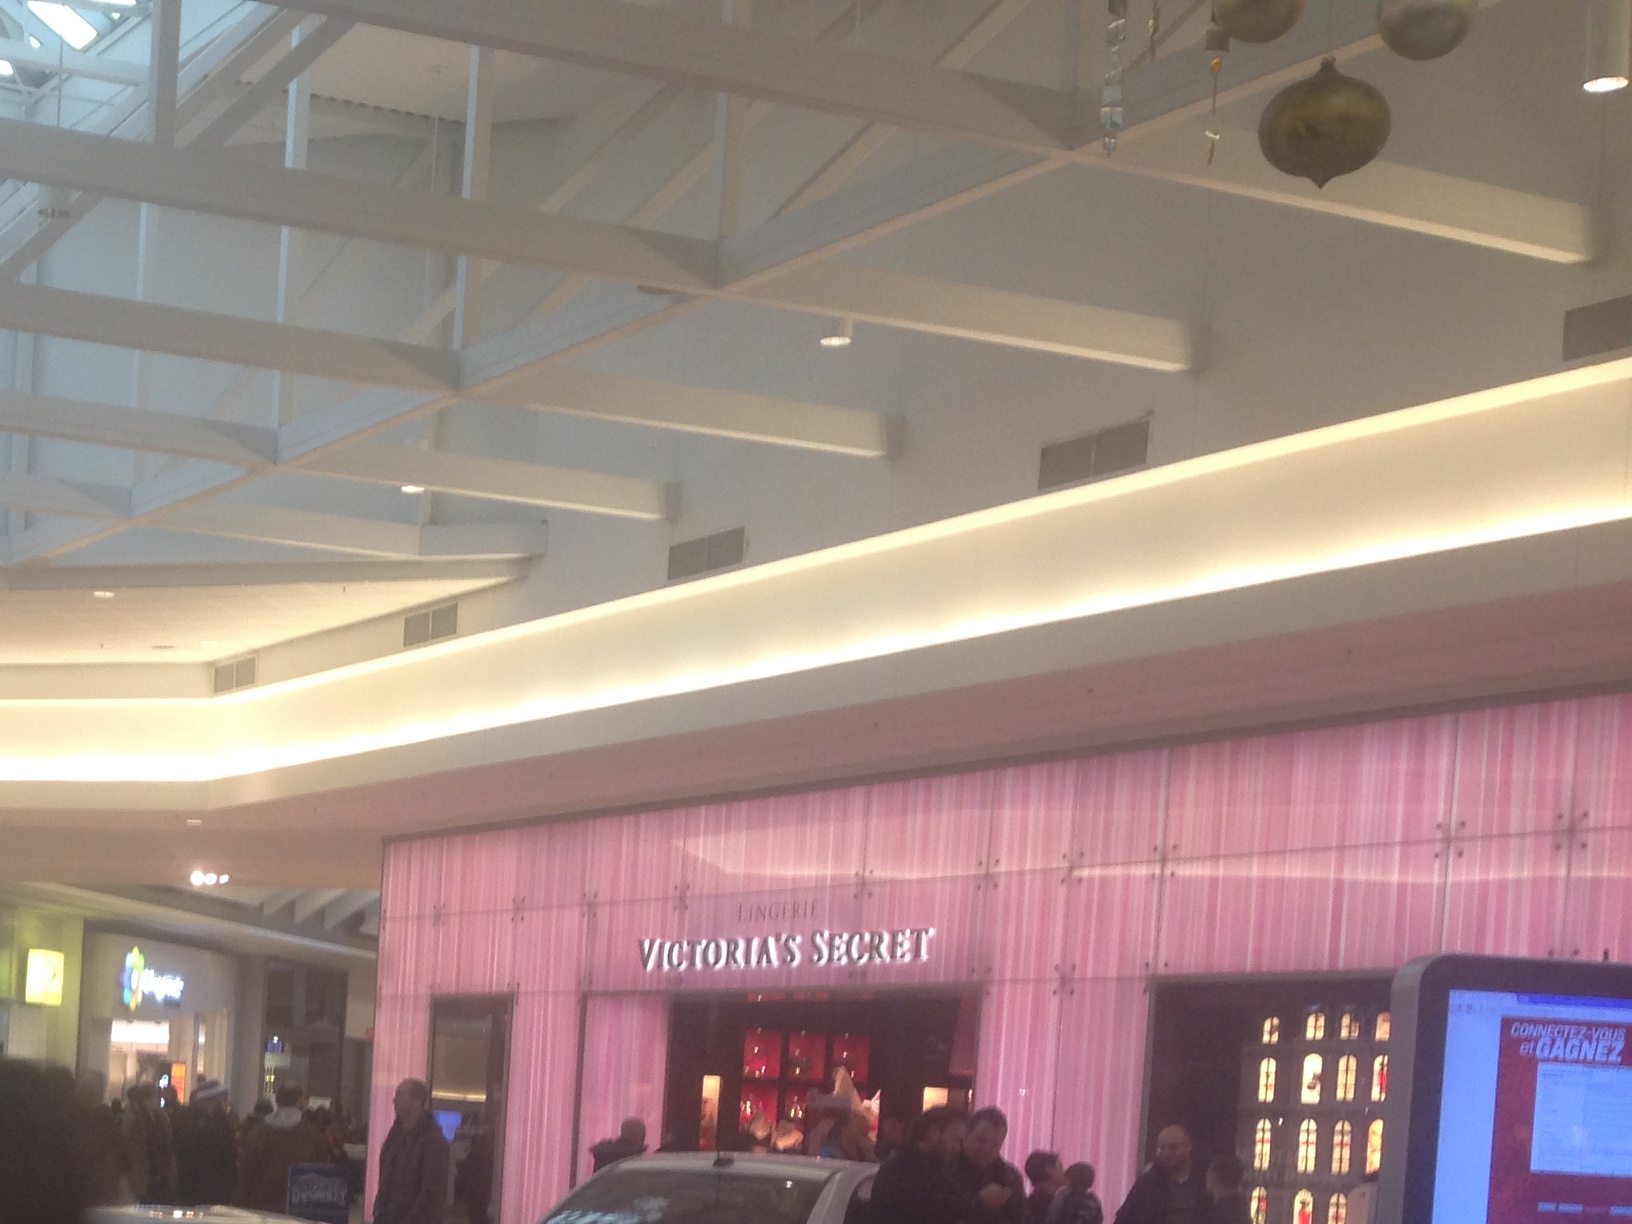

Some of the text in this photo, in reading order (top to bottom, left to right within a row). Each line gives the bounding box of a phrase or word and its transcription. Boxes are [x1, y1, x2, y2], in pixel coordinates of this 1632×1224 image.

[737, 901, 817, 922] LINGERIE
[639, 927, 936, 972] VICTORIA'S SECRET
[1511, 1022, 1626, 1041] CONNECTEZ-VOUS
[1535, 1037, 1625, 1063] GAGNEZ
